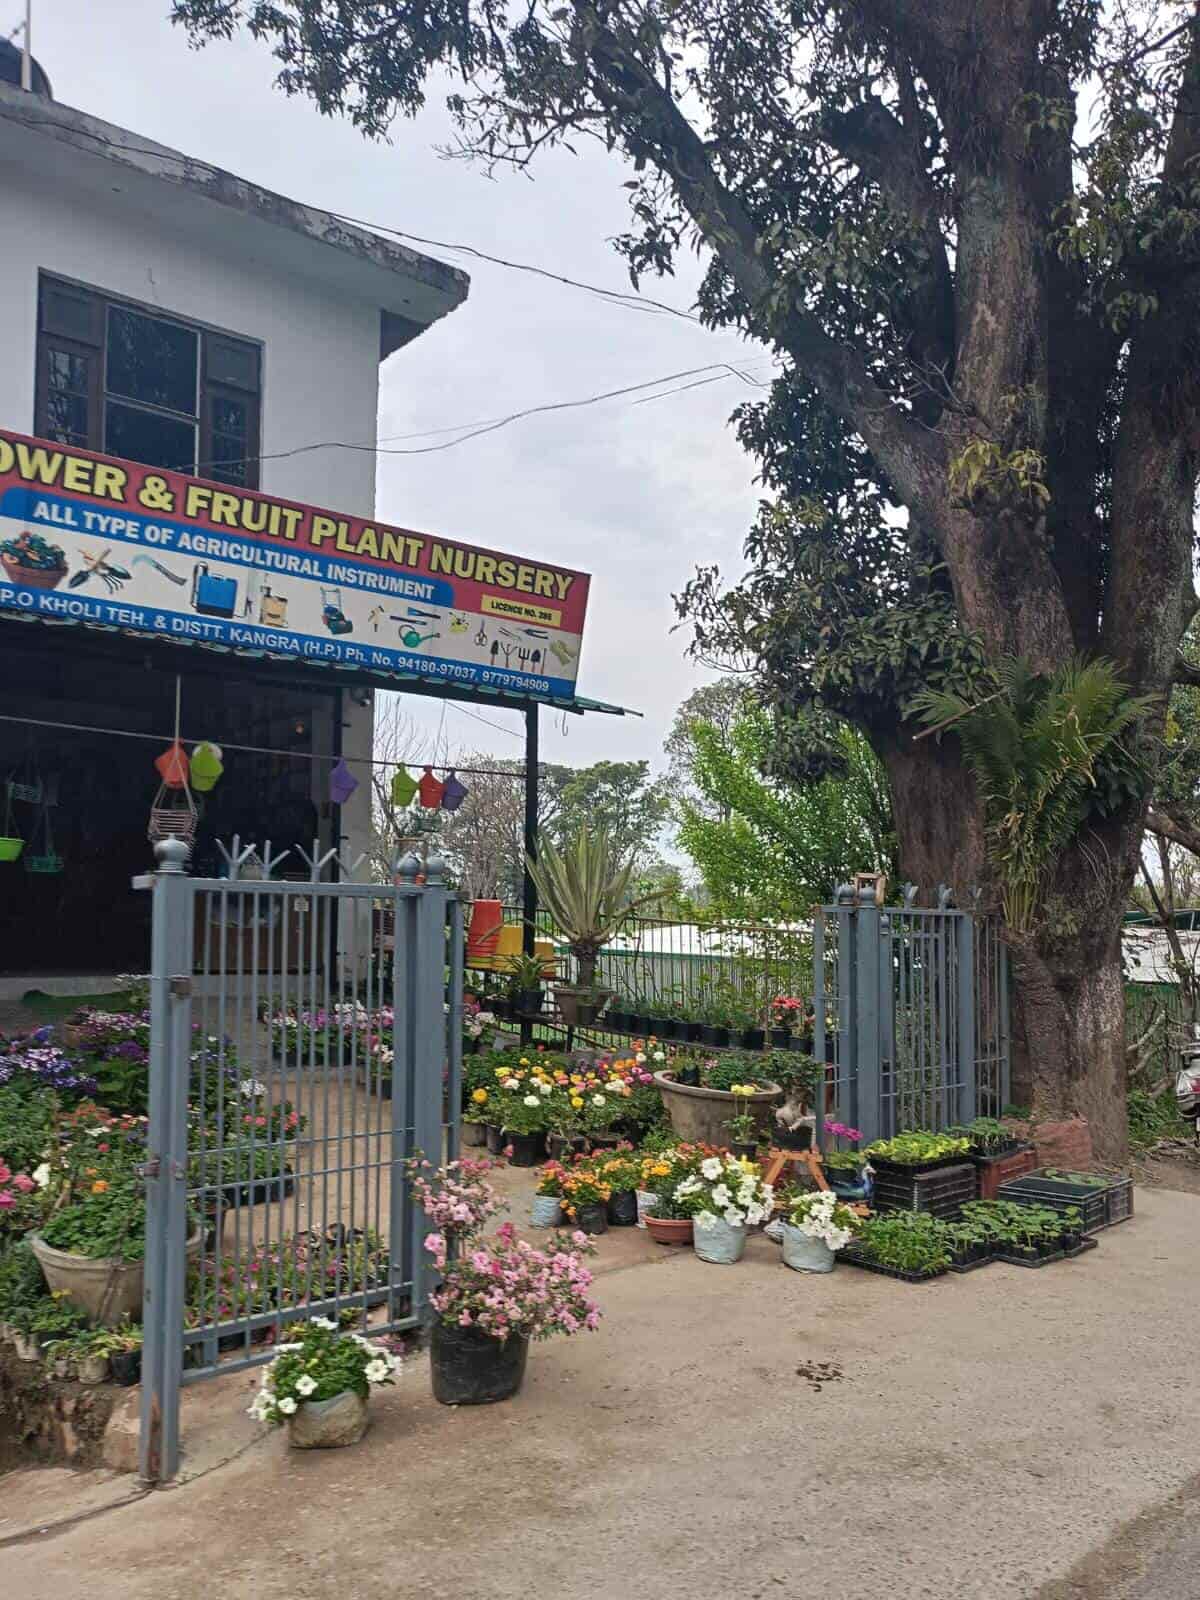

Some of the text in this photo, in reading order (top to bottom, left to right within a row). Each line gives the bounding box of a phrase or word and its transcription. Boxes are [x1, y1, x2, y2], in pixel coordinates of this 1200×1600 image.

[33, 501, 435, 600] ALL TYPE OF AGRICULTURAL INSTRUMENT
[138, 474, 175, 513] &
[184, 484, 303, 541] FRUIT
[310, 515, 424, 568] PLANT
[429, 543, 575, 601] NURSERY
[39, 596, 100, 618] KHOLI
[107, 607, 148, 626] TEH.
[154, 615, 167, 629] &
[172, 618, 224, 639] DISTT.
[230, 628, 300, 651] KANGRA
[304, 640, 342, 659] (H.P.)
[345, 648, 368, 662] Ph.
[372, 652, 393, 667] No.
[491, 600, 523, 616] LICENCE
[524, 608, 537, 618] NO.
